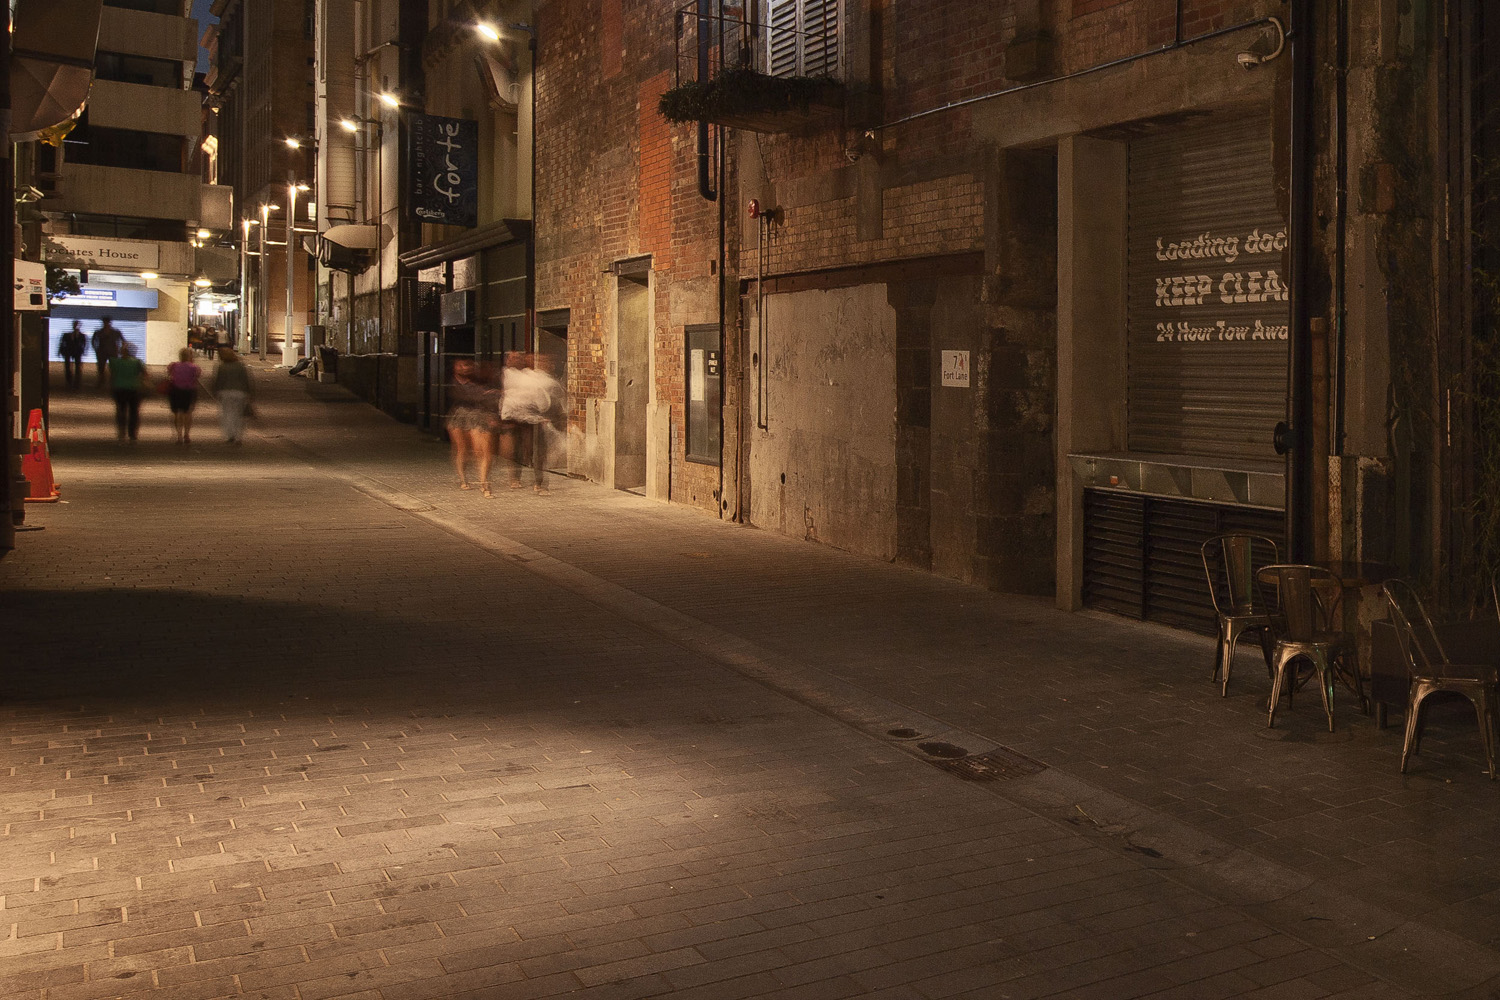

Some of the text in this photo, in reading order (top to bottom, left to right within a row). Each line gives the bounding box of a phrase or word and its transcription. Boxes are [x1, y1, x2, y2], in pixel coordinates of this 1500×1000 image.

[414, 119, 425, 195] bar nightclub
[99, 248, 140, 260] House
[1156, 231, 1239, 263] Loading
[1155, 274, 1213, 307] KEEP
[1156, 319, 1289, 342] 24 Hour Tow Awa
[943, 370, 968, 381] Fort Lane
